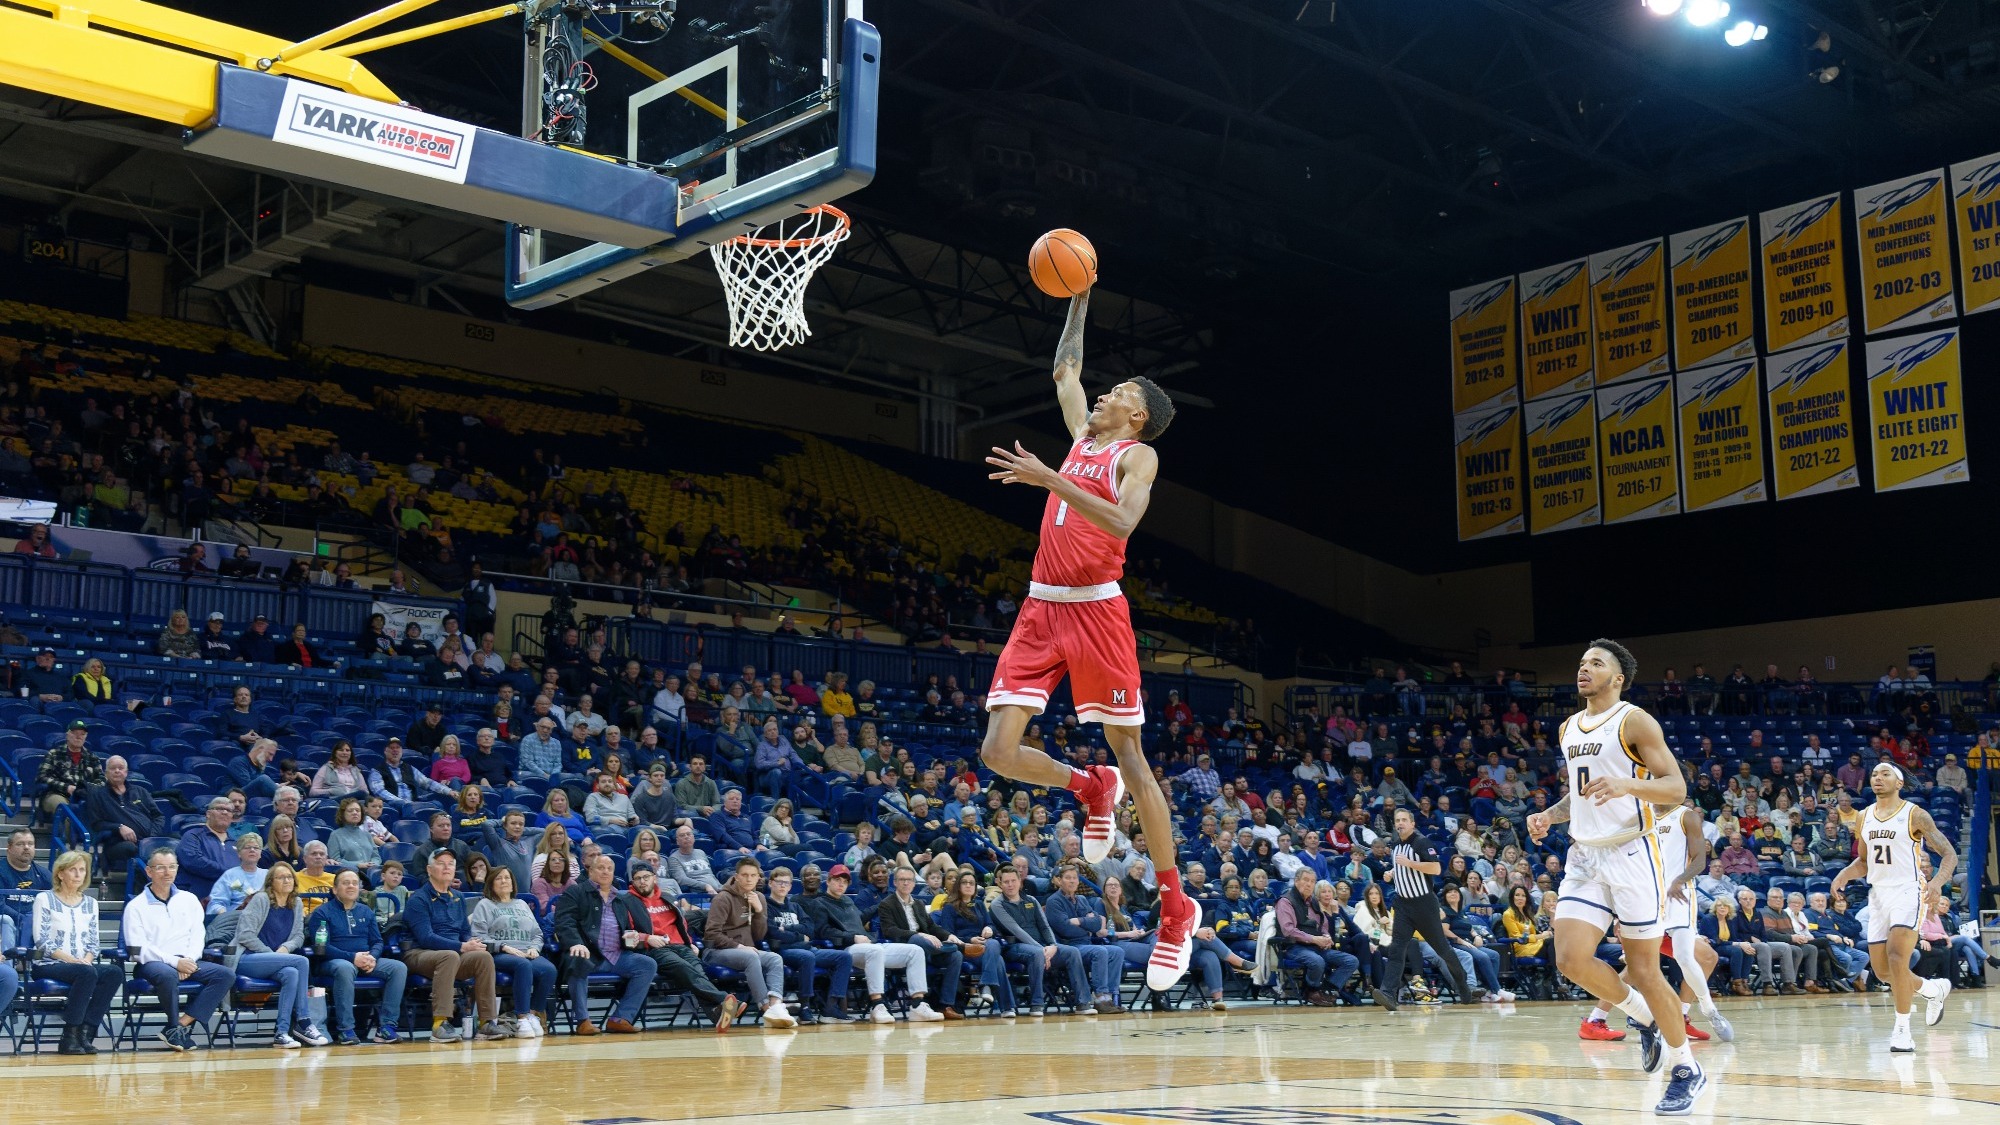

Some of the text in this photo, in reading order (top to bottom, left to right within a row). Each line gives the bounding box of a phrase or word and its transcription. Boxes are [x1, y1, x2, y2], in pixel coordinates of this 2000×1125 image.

[302, 103, 450, 155] YARK AUTO.COM
[1867, 214, 1936, 239] MID-AMERICAN
[32, 240, 65, 260] 204
[1770, 240, 1836, 265] MID-AMERICAN
[1874, 231, 1931, 253] CONFERENCE
[1973, 238, 1990, 251] 1ST
[1776, 254, 1831, 277] CONFERENCE
[1876, 247, 1931, 268] CHAMPIONS
[1676, 270, 1748, 297] MID-AMERICAN
[1792, 272, 1817, 287] WEST
[1874, 271, 1941, 300] 2002-03
[1601, 282, 1655, 302] MID-AMERICAN
[1686, 288, 1739, 309] CONFERENCE
[1779, 282, 1832, 304] CHAMPIONS
[1606, 294, 1651, 312] CONFERENCE
[1688, 303, 1739, 323] CHAMPIONS
[1780, 300, 1834, 326] 2009-10
[1531, 304, 1580, 336] WNIT
[1618, 310, 1640, 323] WEST
[1600, 320, 1661, 341] CO-CHAMPIONS
[1691, 321, 1738, 344] 2010-11
[1527, 332, 1587, 357] ELITE EIGHT
[1609, 339, 1652, 361] 2011-12
[1465, 364, 1505, 385] 2012-13
[1537, 354, 1578, 375] 2011-12
[1776, 390, 1846, 416] MID-AMERICAN
[1883, 381, 1948, 416] WNIT
[1698, 405, 1742, 432] WNIT
[1783, 405, 1840, 429] CONFERENCE
[1878, 413, 1958, 440] ELITE EIGHT
[1609, 425, 1665, 456] NCAA
[1715, 425, 1749, 442] ROUND
[1779, 423, 1848, 450] CHAMPIONS
[1532, 437, 1591, 458] MID-AMERICAN
[1891, 439, 1949, 462] 2021-22
[1465, 448, 1511, 477] WNIT
[1538, 450, 1587, 469] CONFERENCE
[1606, 456, 1671, 477] TOURNAMENT
[1790, 447, 1840, 472] 2021-22
[1466, 476, 1515, 497] SWEET 16
[1533, 466, 1592, 489] CHAMPIONS
[1617, 476, 1662, 497] 2016-17
[1471, 497, 1512, 517] 2012-13
[1543, 488, 1584, 509] 2016-17
[407, 608, 443, 619] ROCKET
[1112, 688, 1127, 705] M
[1567, 743, 1603, 761] TOLEDO
[1577, 766, 1590, 797] 0
[1658, 825, 1671, 835] EDO
[1868, 829, 1896, 841] TOLEDO
[1873, 844, 1892, 865] 21
